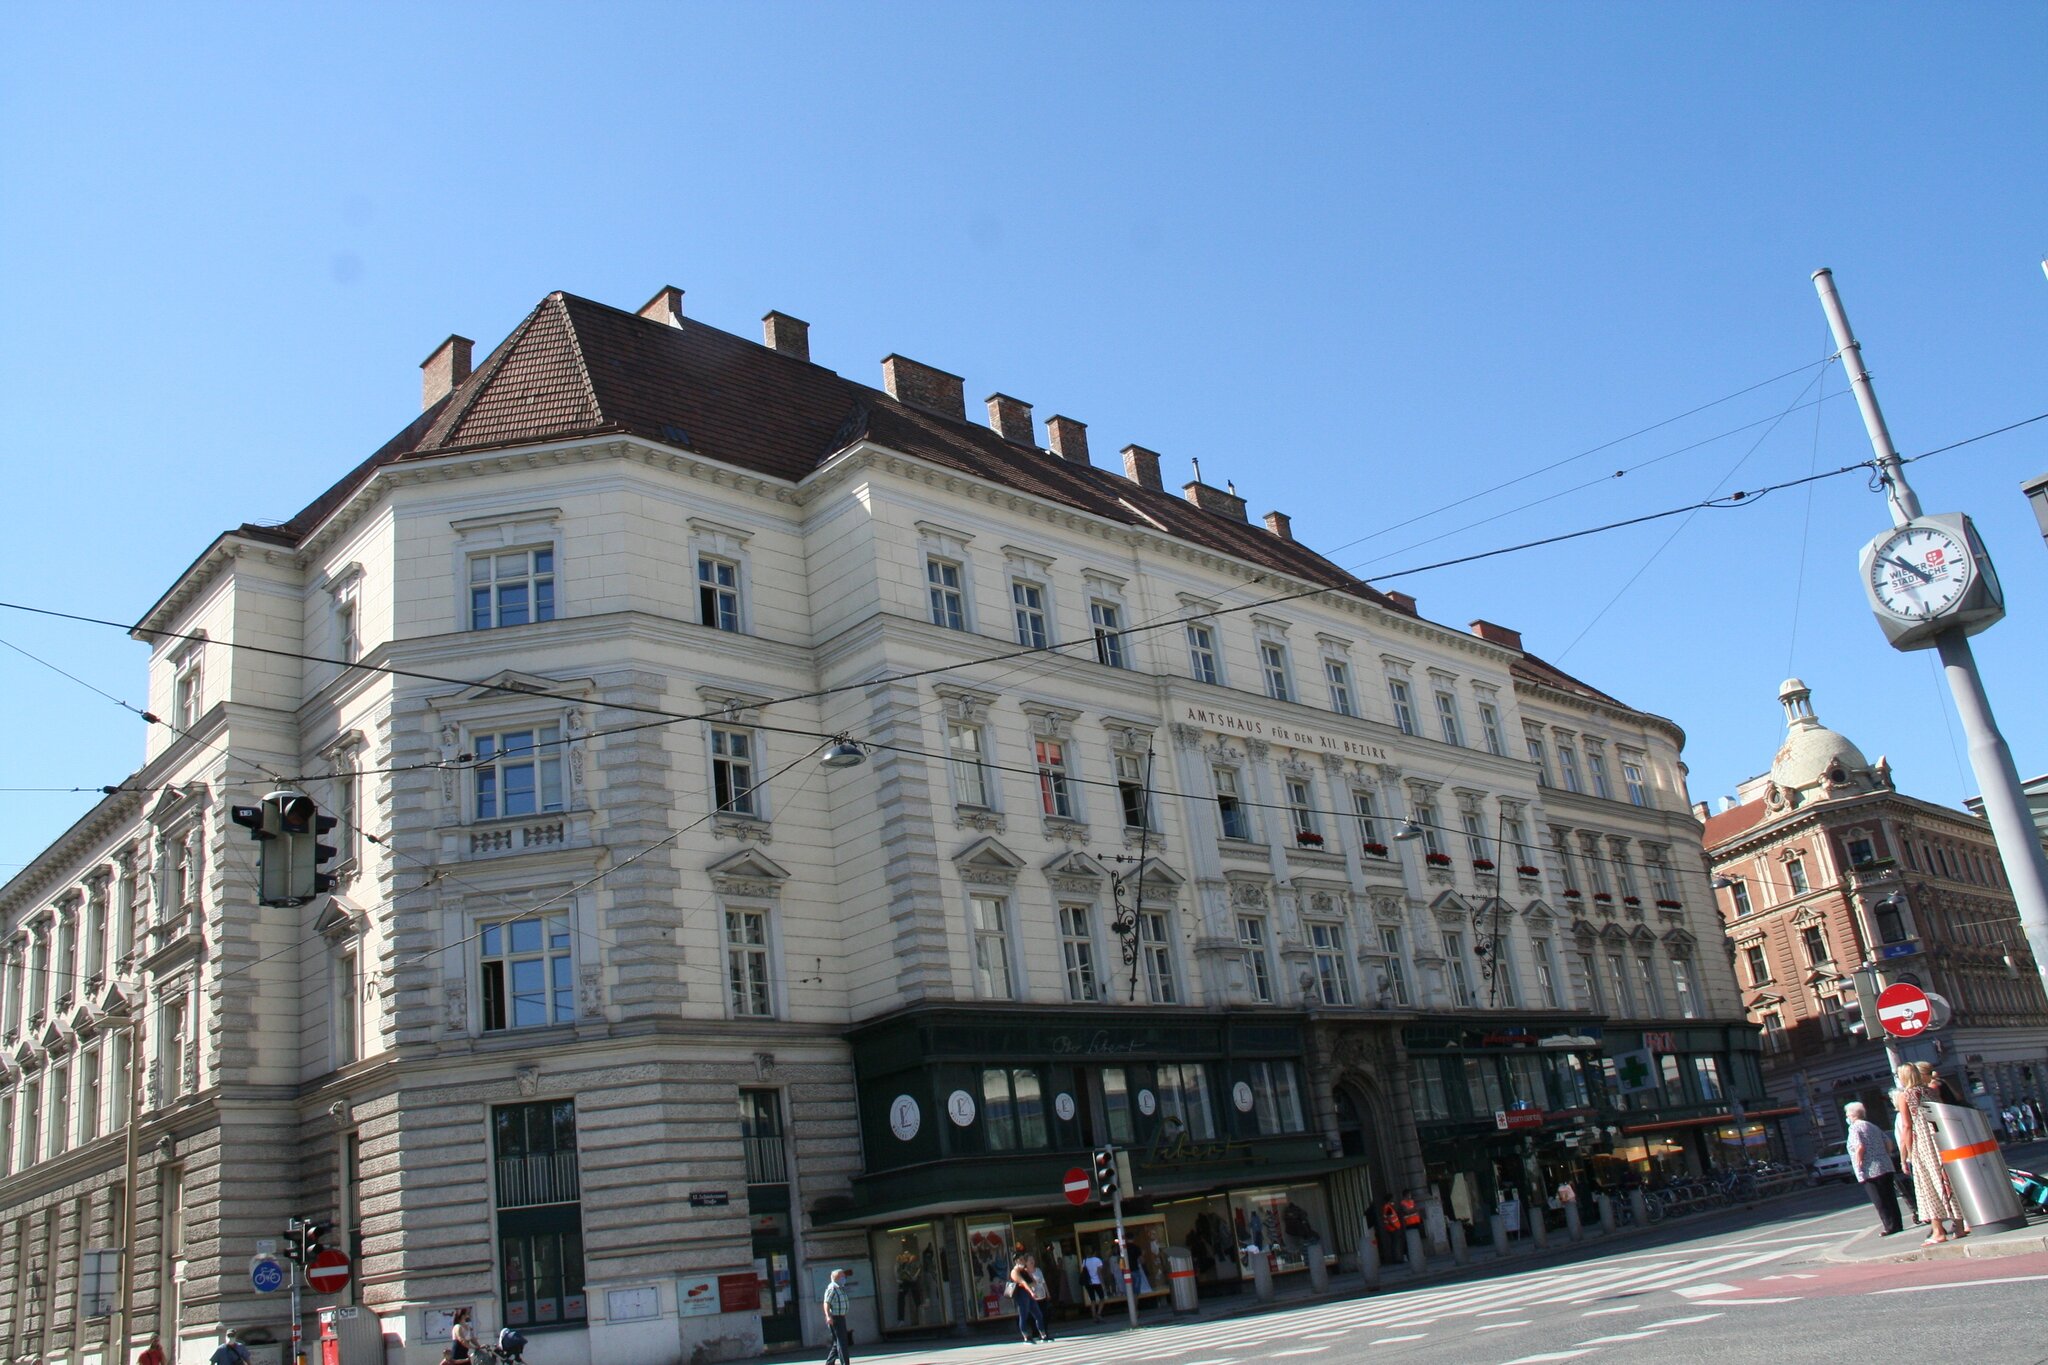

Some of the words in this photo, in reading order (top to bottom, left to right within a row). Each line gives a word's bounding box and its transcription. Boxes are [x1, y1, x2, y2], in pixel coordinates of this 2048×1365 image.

[1890, 562, 1928, 579] WIEER
[1187, 708, 1263, 734] AMTSHAUS
[1272, 726, 1290, 740] FÜR
[1294, 732, 1314, 745] DEN
[1344, 741, 1387, 760] BEZIRK
